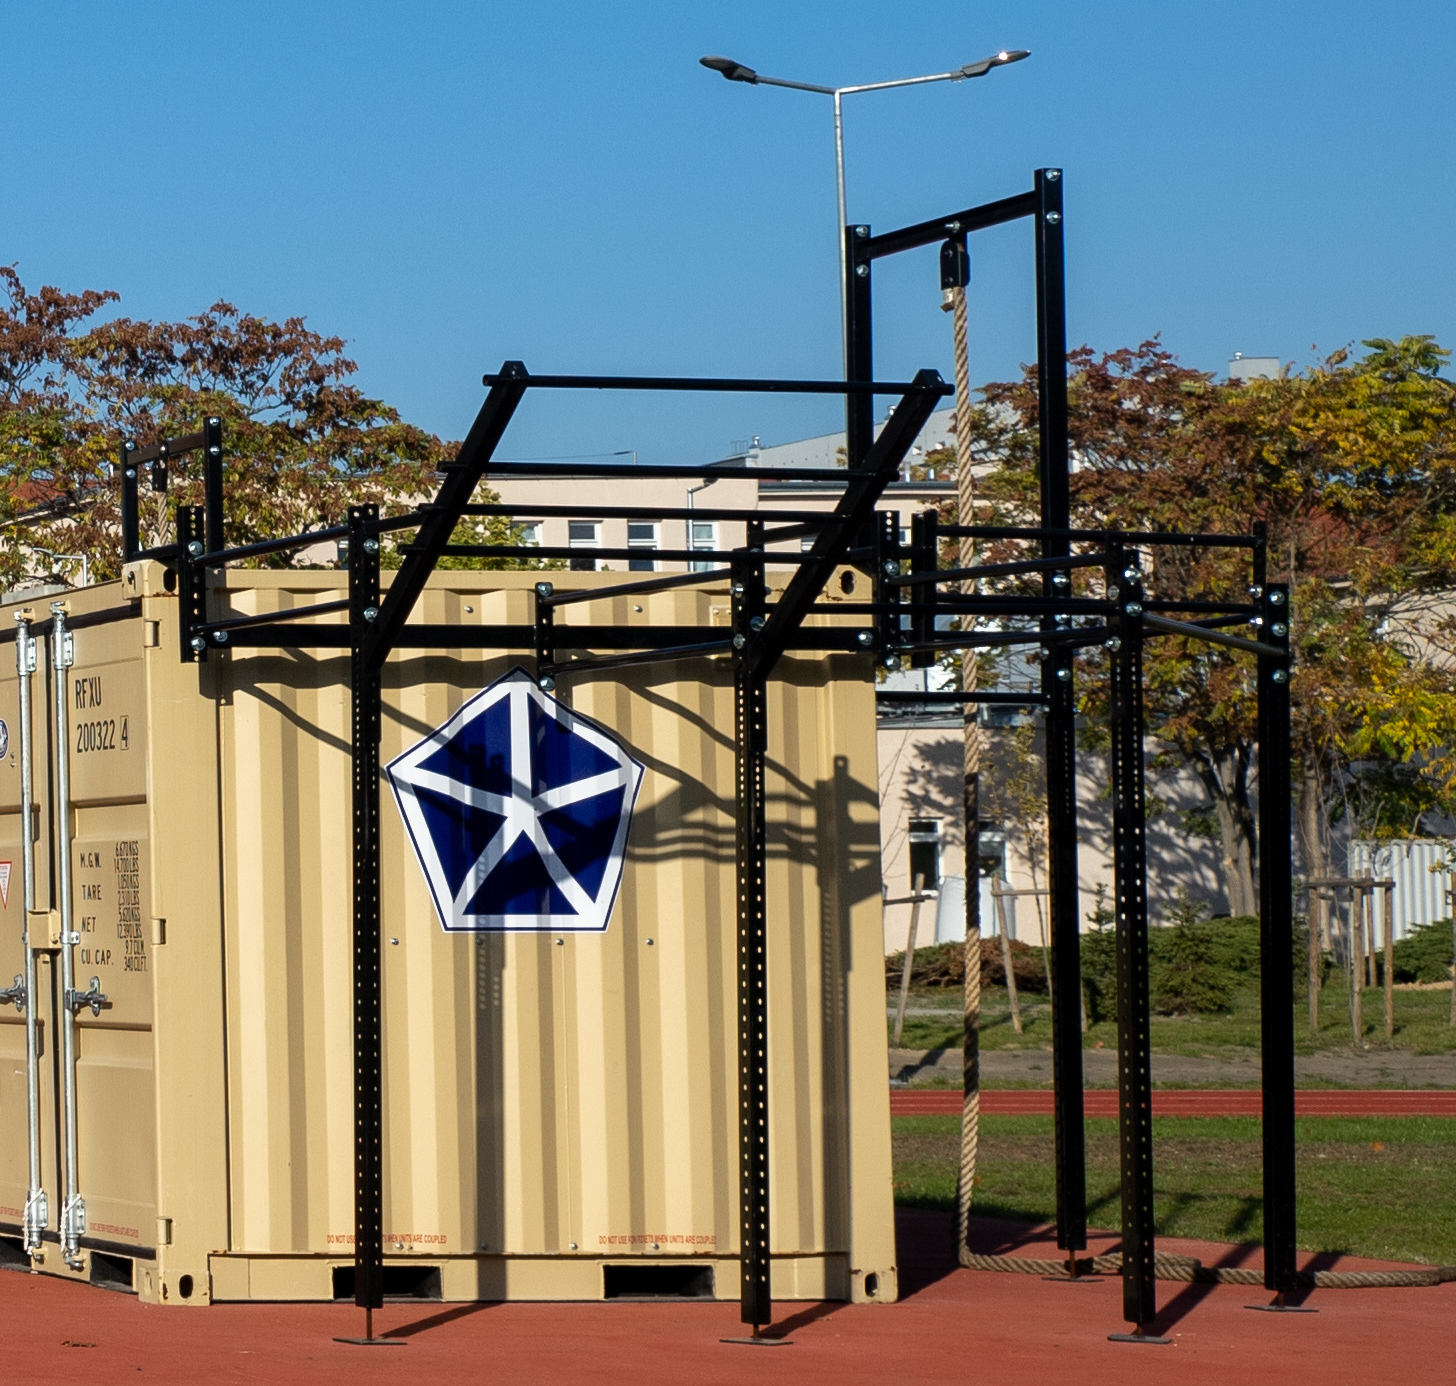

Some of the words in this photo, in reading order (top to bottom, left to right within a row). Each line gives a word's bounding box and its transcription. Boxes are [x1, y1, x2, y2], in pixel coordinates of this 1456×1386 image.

[75, 676, 102, 710] RFXU
[77, 718, 116, 754] 200322
[121, 717, 128, 749] 4
[80, 852, 102, 869] M.G.W.
[82, 884, 102, 901] TARE
[81, 916, 97, 933] NET
